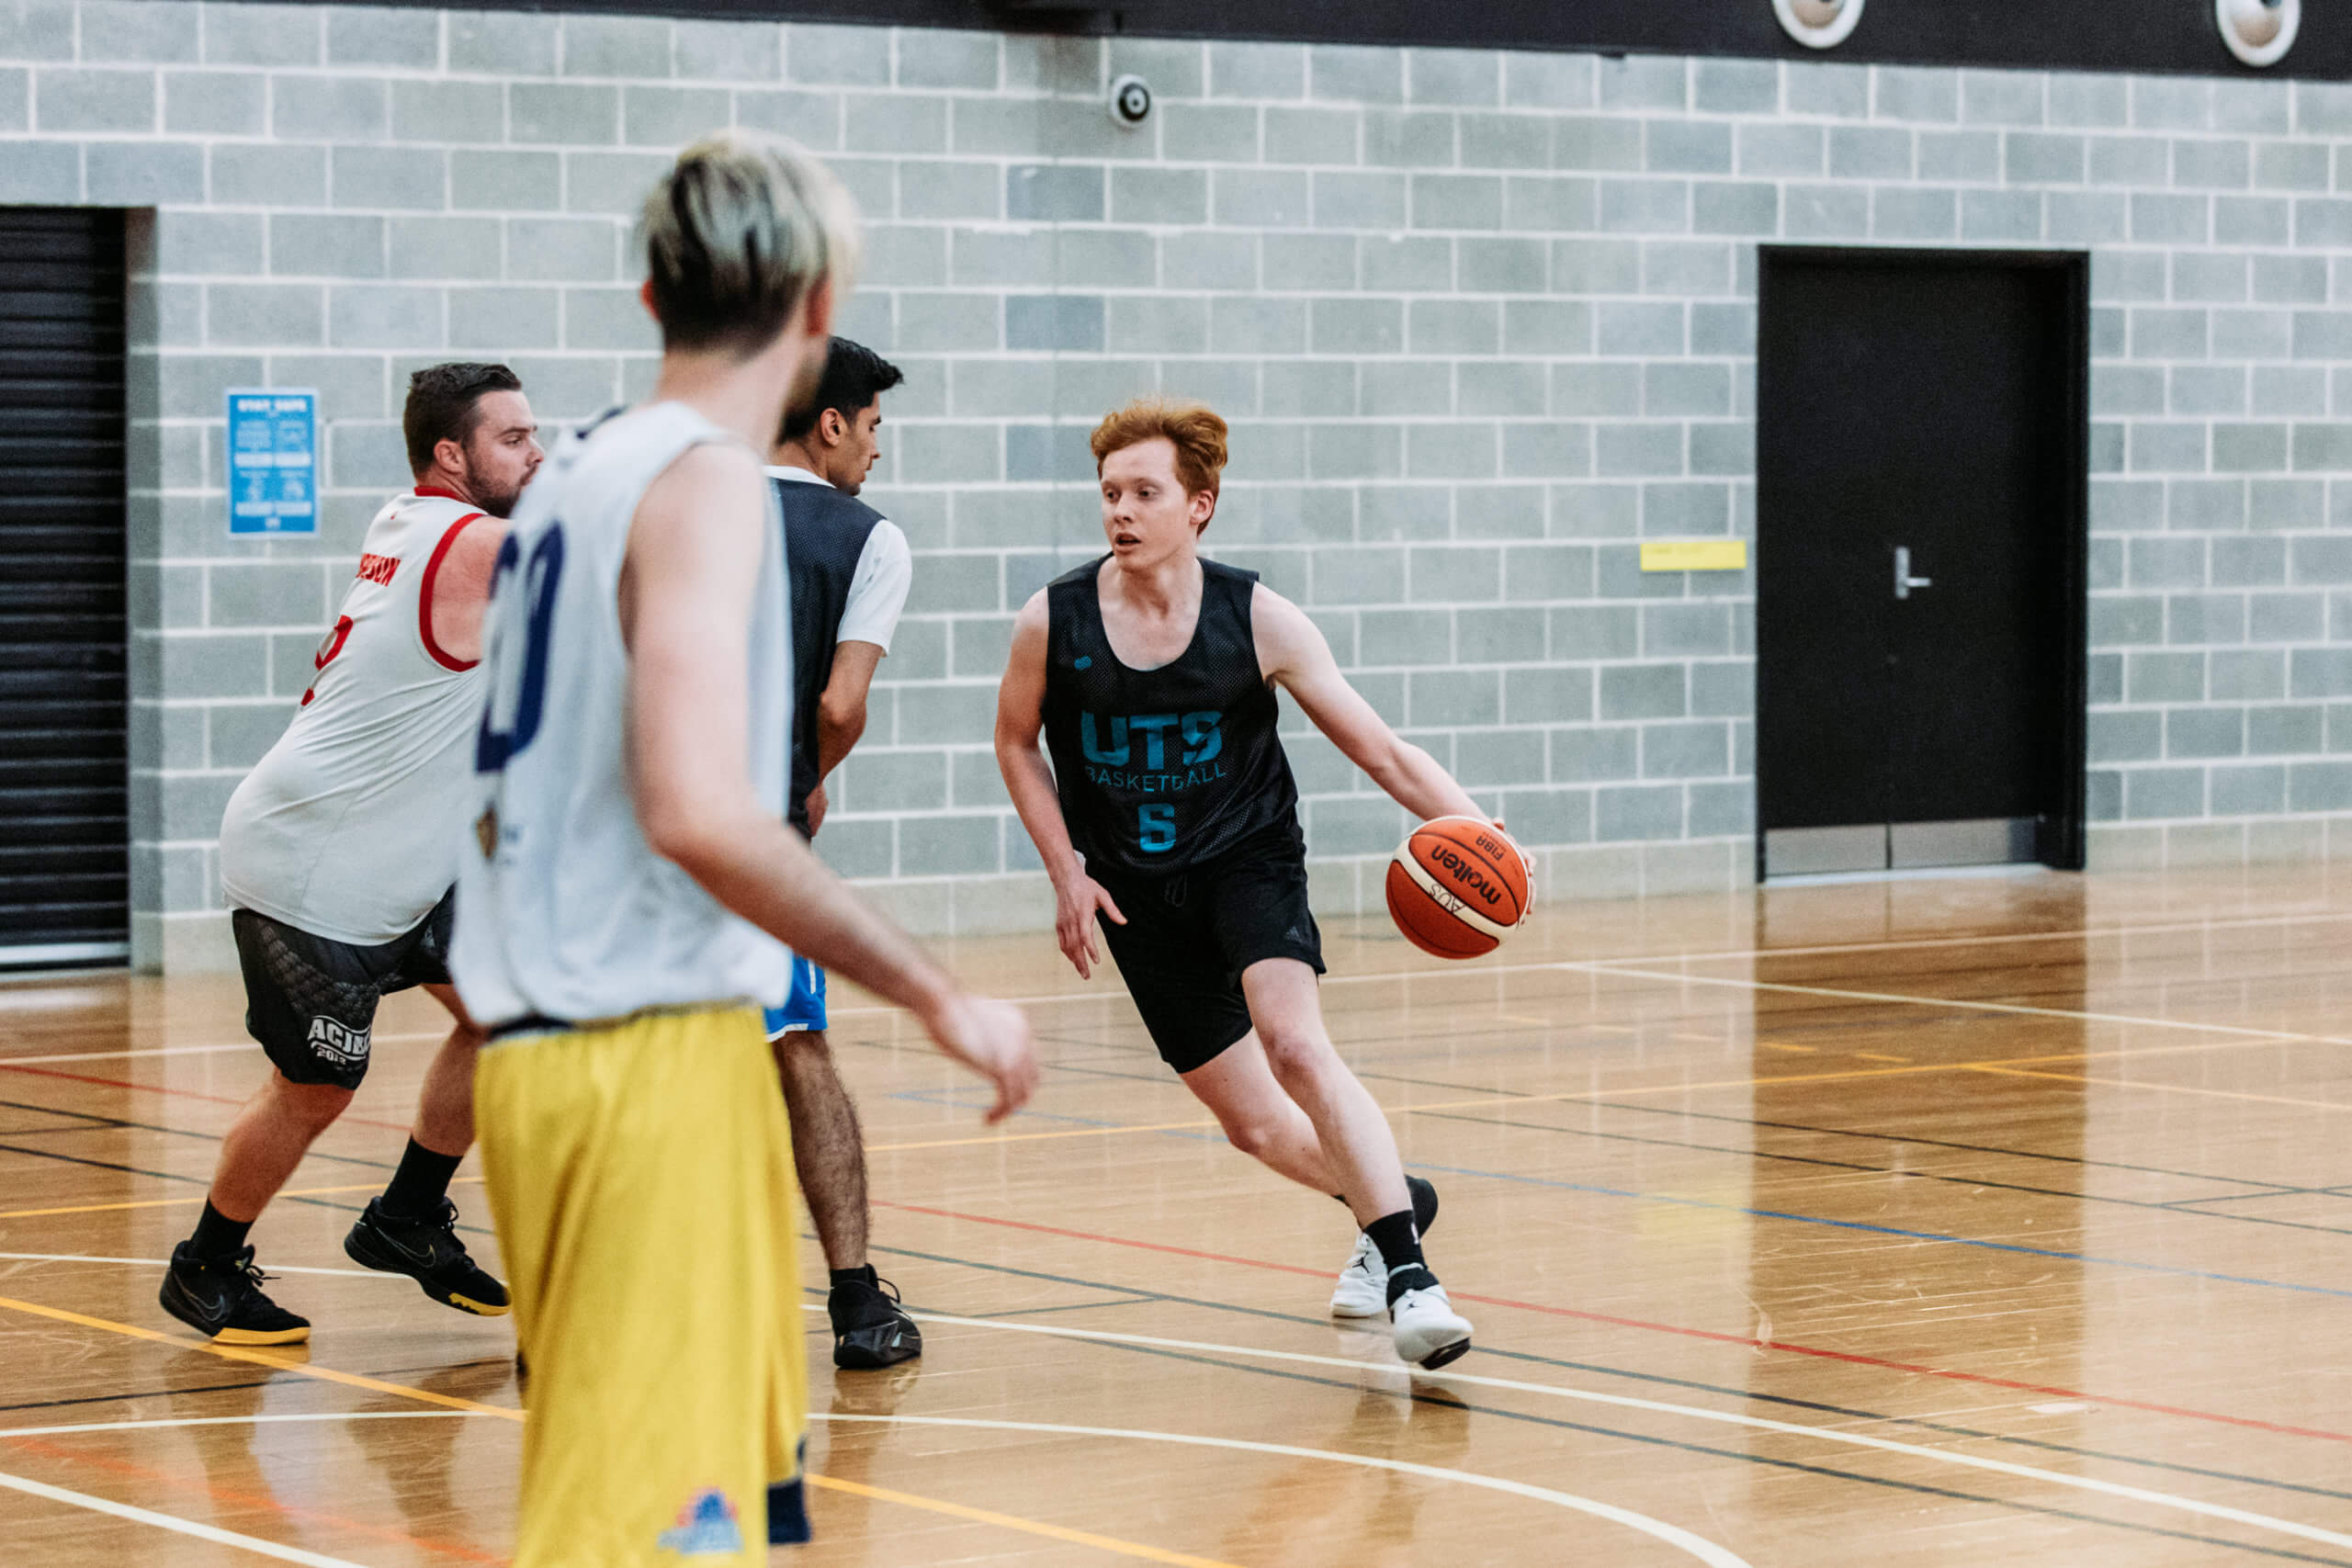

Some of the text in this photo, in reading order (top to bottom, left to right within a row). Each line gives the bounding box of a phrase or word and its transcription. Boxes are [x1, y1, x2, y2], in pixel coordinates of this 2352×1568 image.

[1081, 710, 1223, 770] UTS
[1085, 762, 1227, 793] BASKETBALL
[1138, 803, 1176, 852] 6
[1476, 837, 1504, 860] FIBA
[1431, 845, 1500, 904] molten
